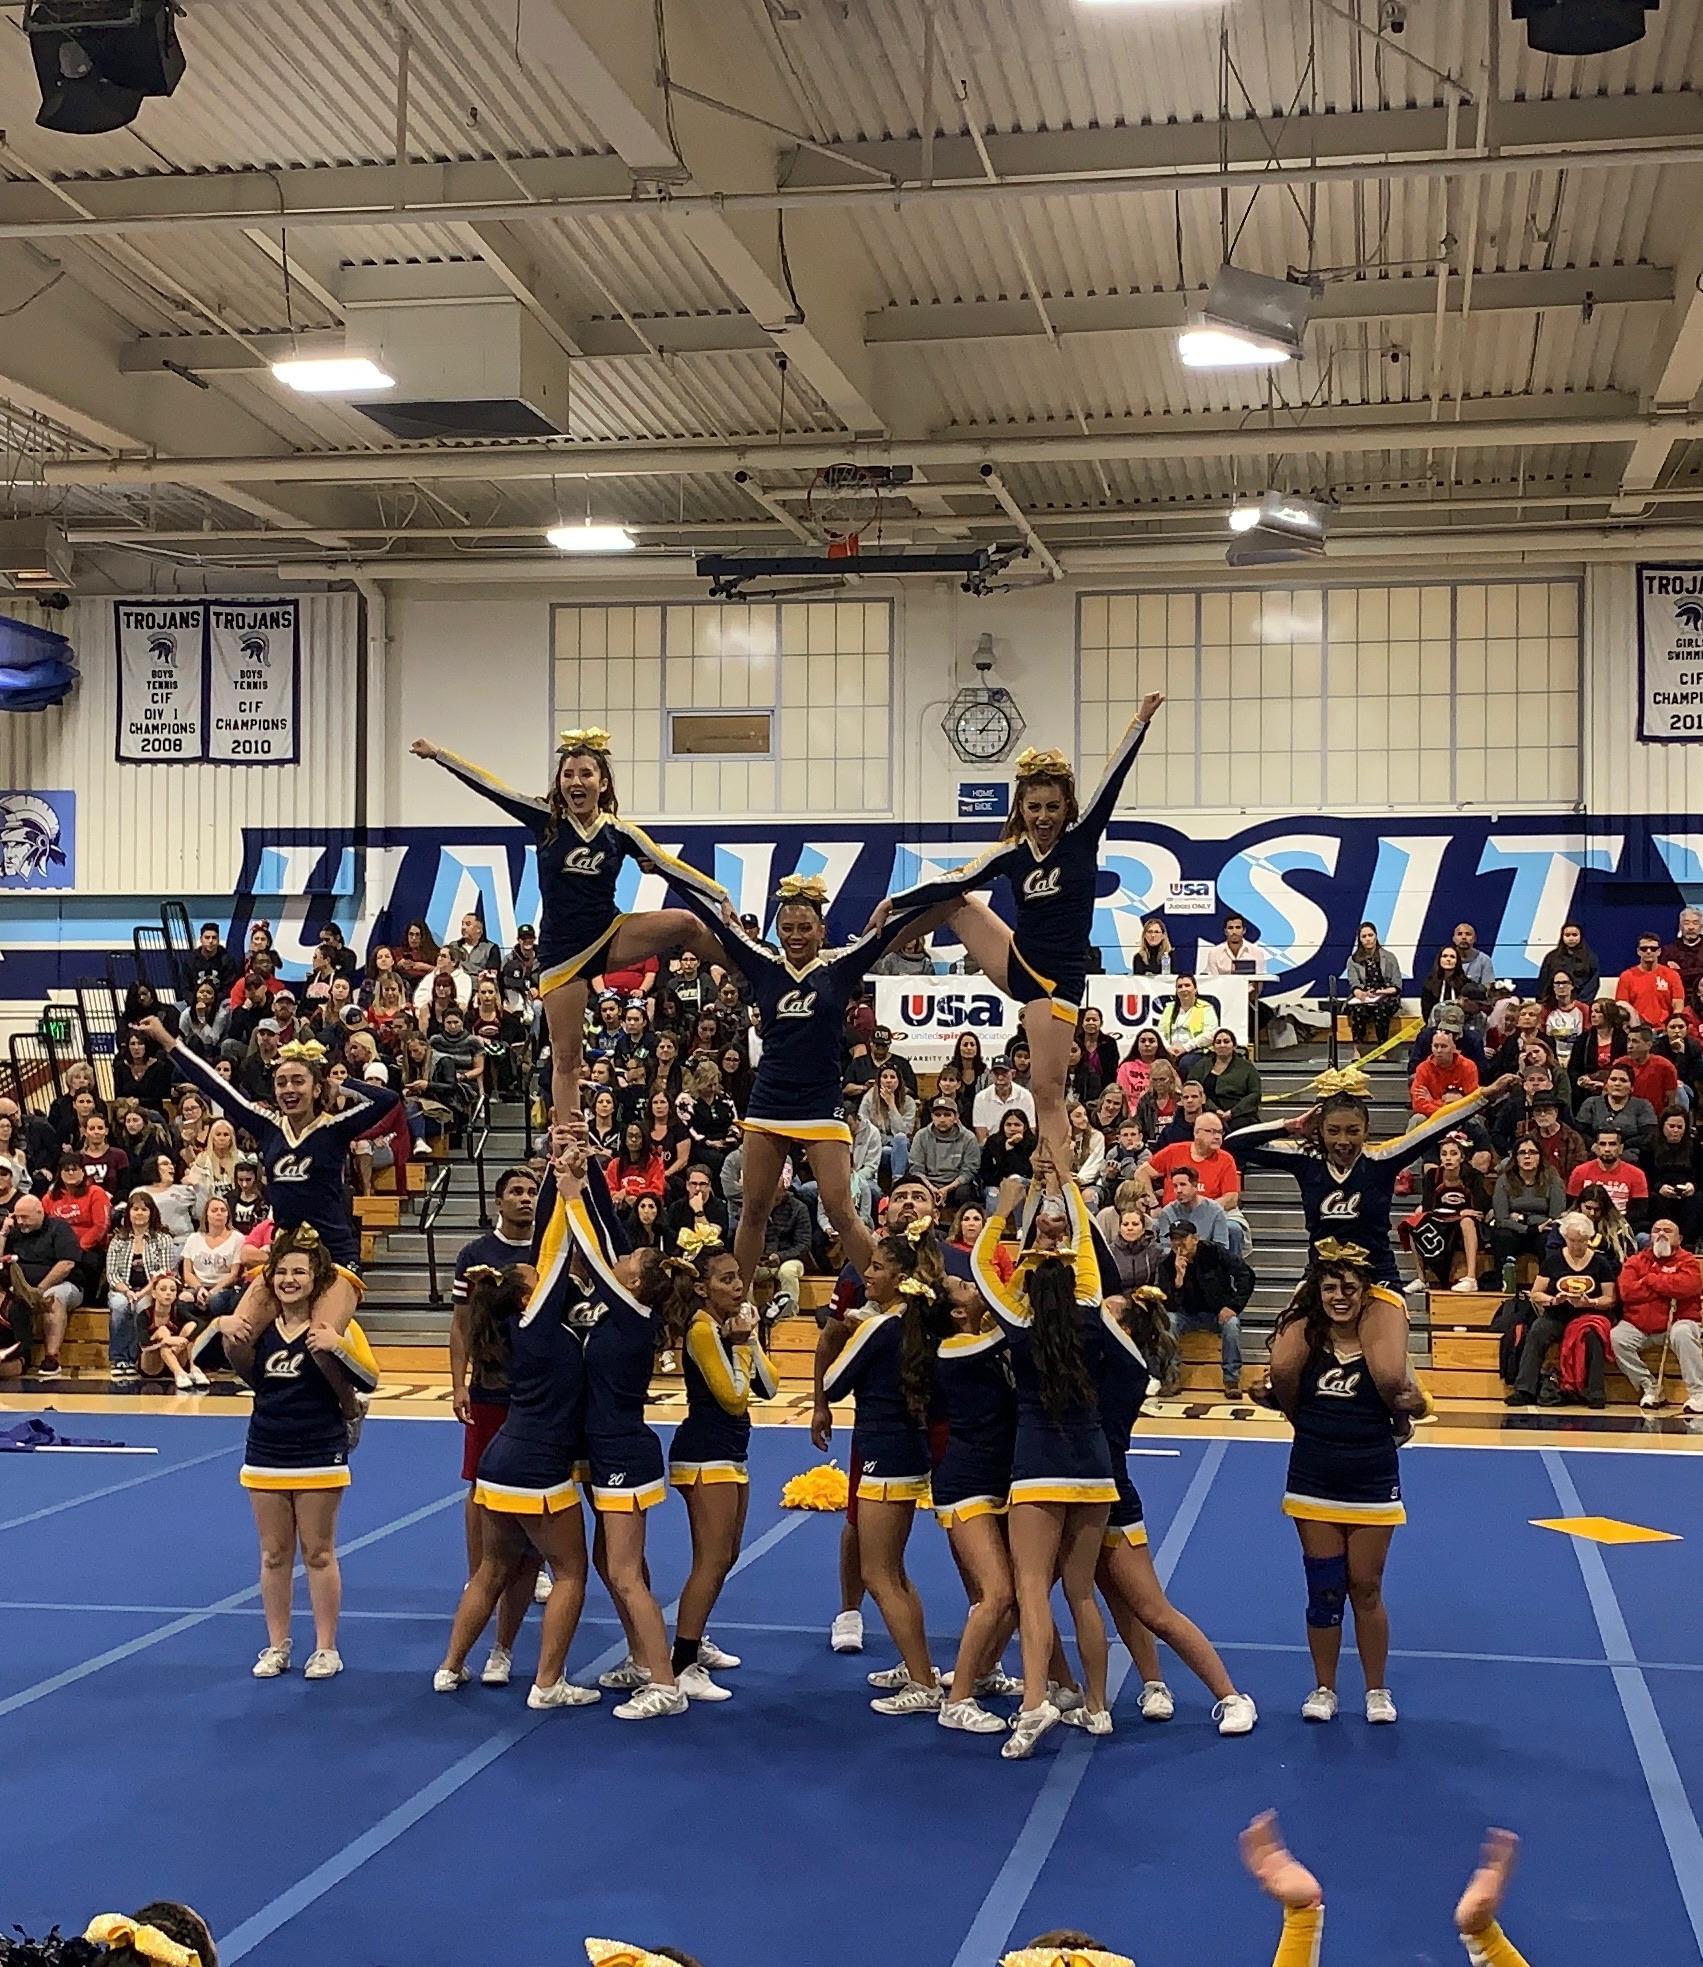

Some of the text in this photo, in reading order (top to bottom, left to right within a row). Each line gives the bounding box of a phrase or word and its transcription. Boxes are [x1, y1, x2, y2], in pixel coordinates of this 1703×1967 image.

[124, 612, 200, 629] TROJANS
[213, 611, 292, 629] TROJANS
[1676, 638, 1703, 648] GIRL
[151, 670, 174, 679] BOYS
[240, 670, 263, 679] BOYS
[1680, 672, 1703, 685] CIF
[146, 681, 178, 690] TENNIS
[233, 681, 268, 690] TENNIS
[151, 692, 173, 704] CIF
[238, 701, 263, 713] CIF
[144, 709, 164, 720] DIV
[129, 722, 195, 735] CHAMPIONS
[215, 718, 287, 731] CHAMPIONS
[141, 738, 182, 752] 2008
[231, 740, 271, 754] 2010
[972, 789, 994, 798] HOME
[974, 802, 993, 811] SIDE
[562, 846, 605, 875] Cal
[1023, 867, 1061, 901] Cal
[776, 990, 817, 1019] Cal
[273, 1154, 312, 1182] Cal
[1320, 1190, 1361, 1220] Cal
[264, 1350, 304, 1378] Cal
[1315, 1368, 1361, 1397] Cal
